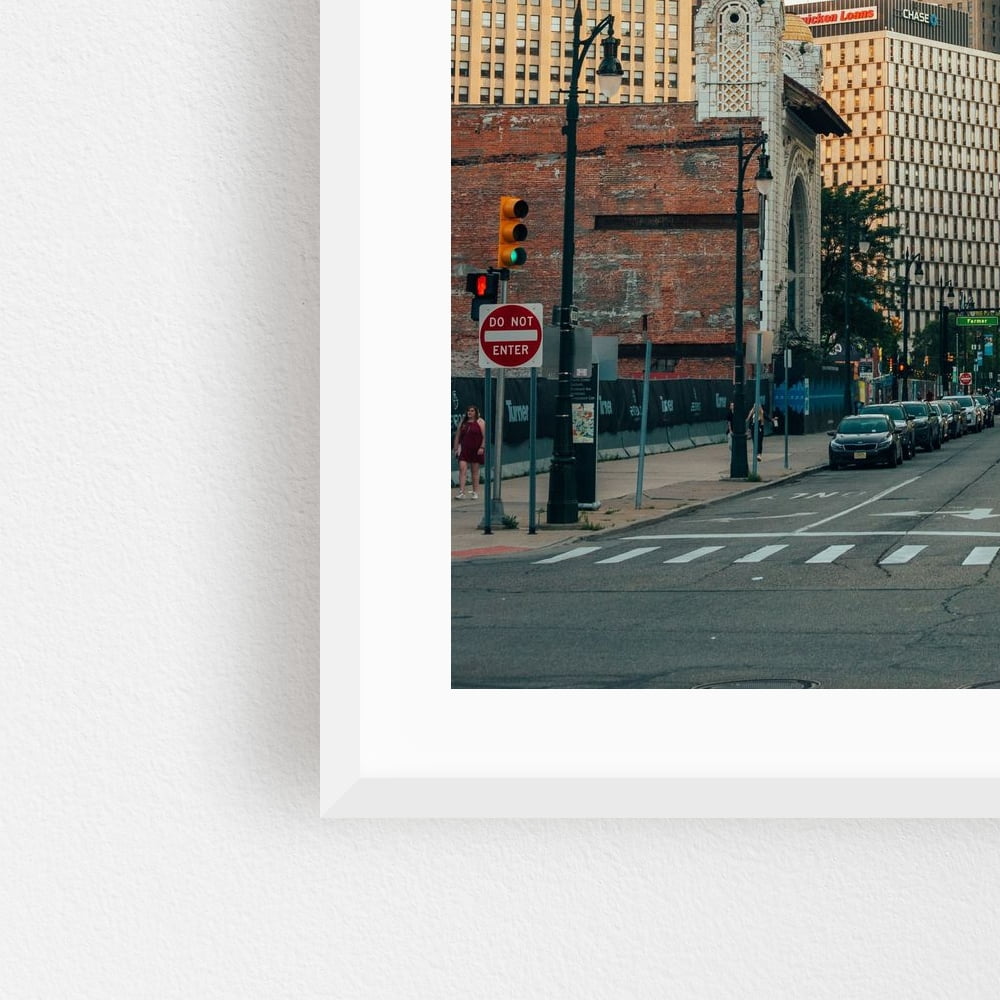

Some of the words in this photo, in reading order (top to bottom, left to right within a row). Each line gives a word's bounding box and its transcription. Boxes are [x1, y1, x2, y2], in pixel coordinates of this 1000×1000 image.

[802, 13, 838, 25] uicken
[840, 9, 874, 21] Loans
[903, 9, 930, 24] CHASE
[489, 317, 505, 327] DO
[511, 316, 533, 327] NOT
[493, 344, 529, 356] ENTER
